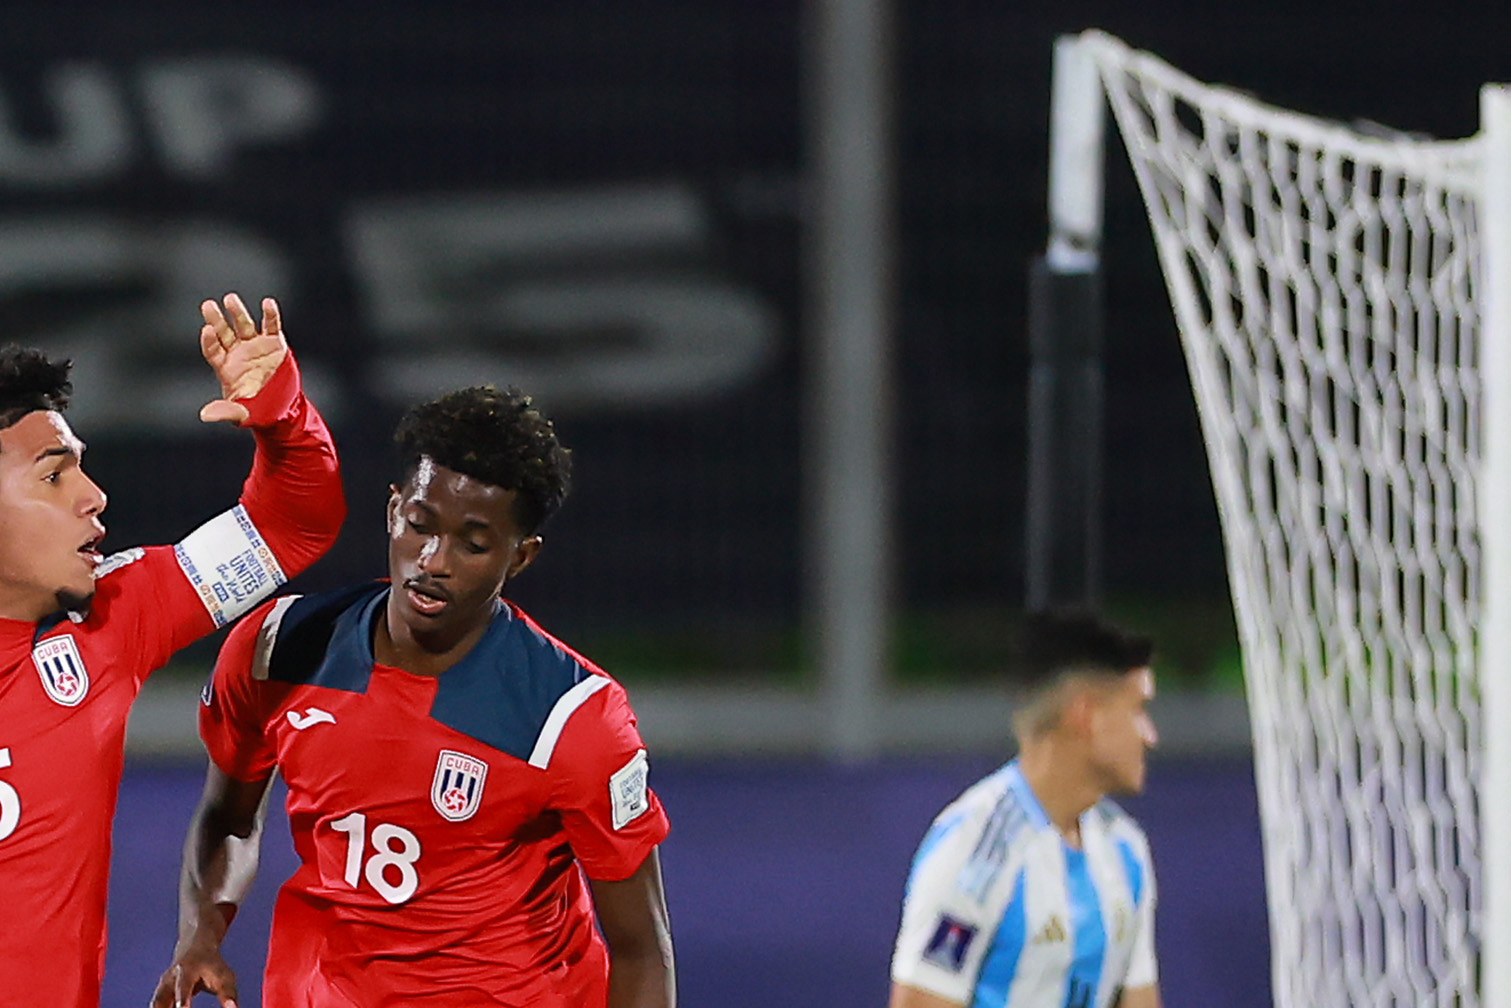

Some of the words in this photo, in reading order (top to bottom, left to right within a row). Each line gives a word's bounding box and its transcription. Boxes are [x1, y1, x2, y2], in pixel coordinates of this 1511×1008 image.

[229, 555, 260, 595] UNITES
[37, 641, 68, 659] CUBA
[446, 757, 480, 775] CUBA
[330, 812, 421, 904] 18
